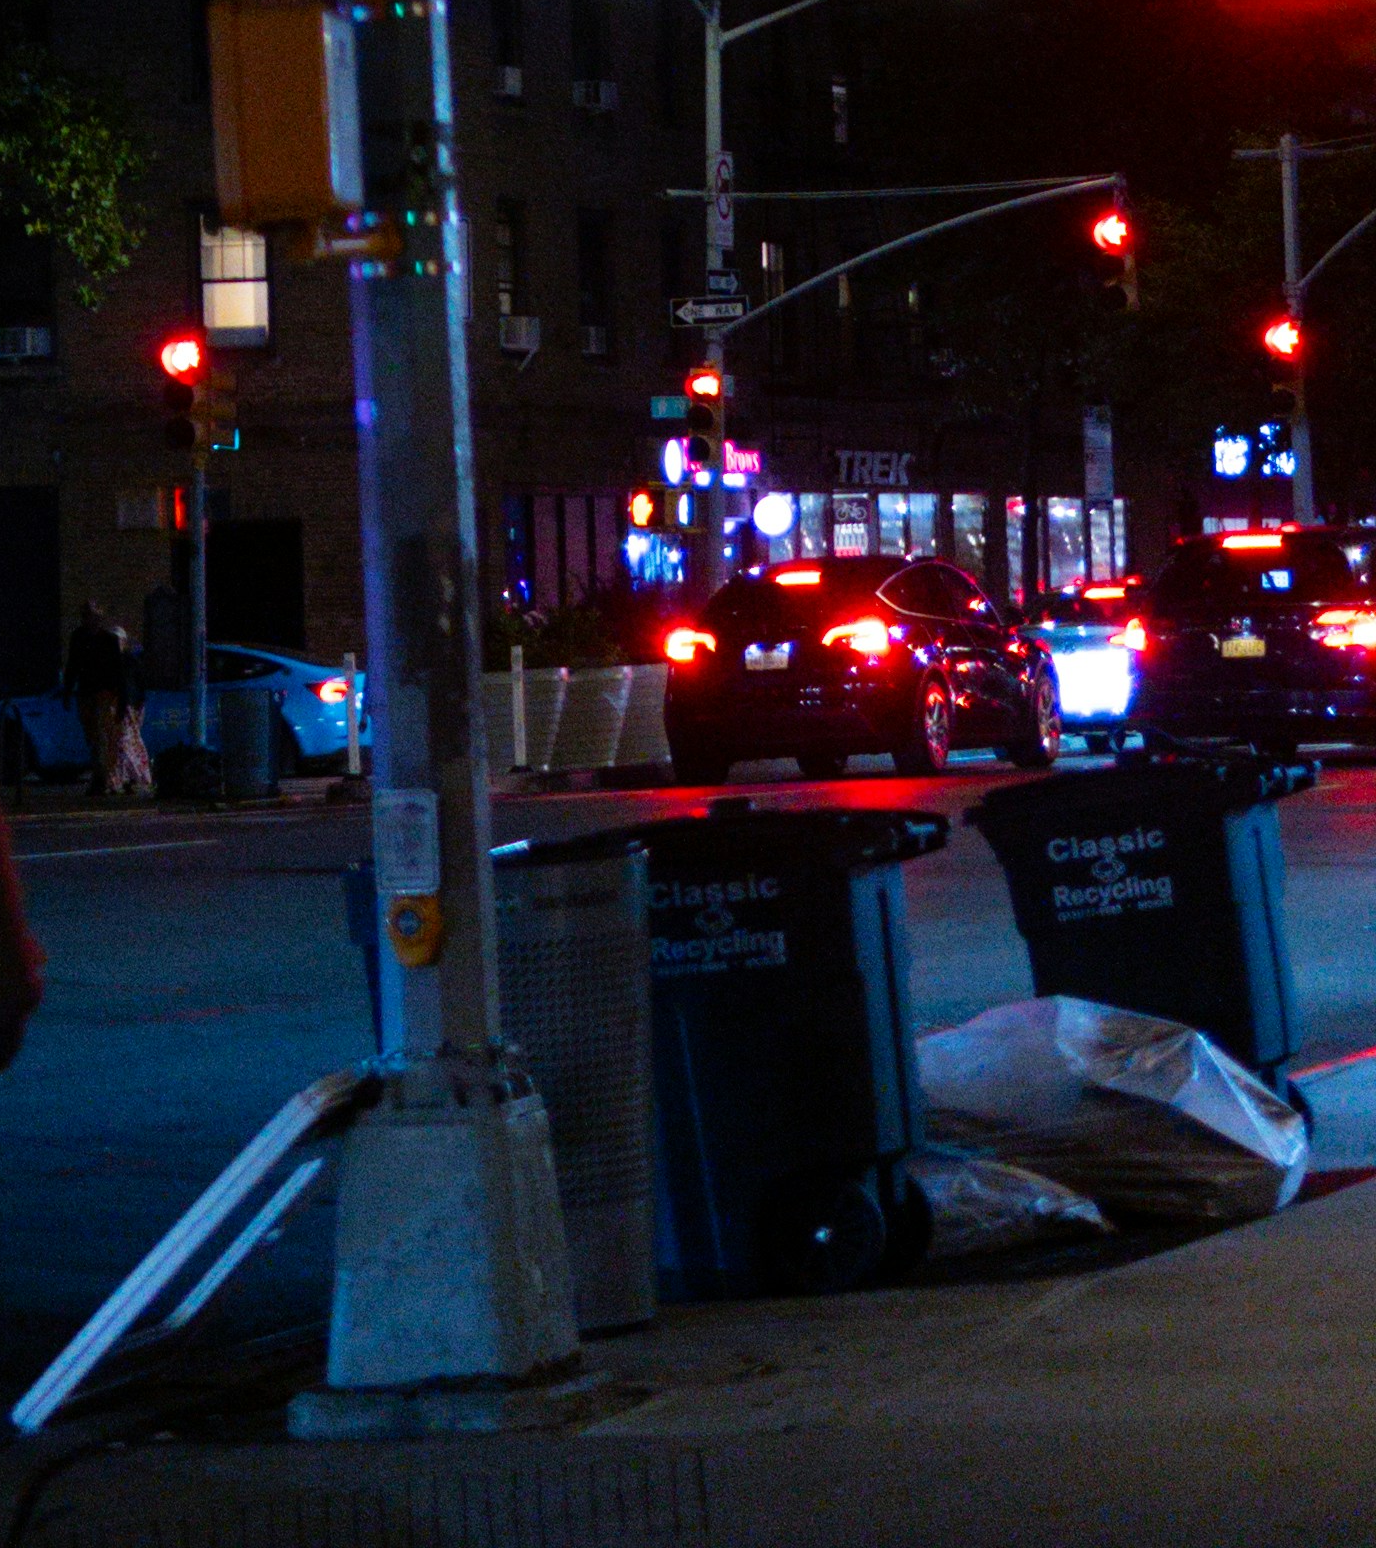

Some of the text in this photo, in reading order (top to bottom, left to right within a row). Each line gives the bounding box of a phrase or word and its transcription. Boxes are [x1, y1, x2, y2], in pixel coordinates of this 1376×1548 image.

[715, 304, 738, 316] WAY
[835, 450, 911, 486] TREK
[1047, 826, 1166, 863] Classic
[648, 873, 781, 910] Classic
[1052, 875, 1173, 908] Recycling
[650, 929, 786, 962] Recycling
